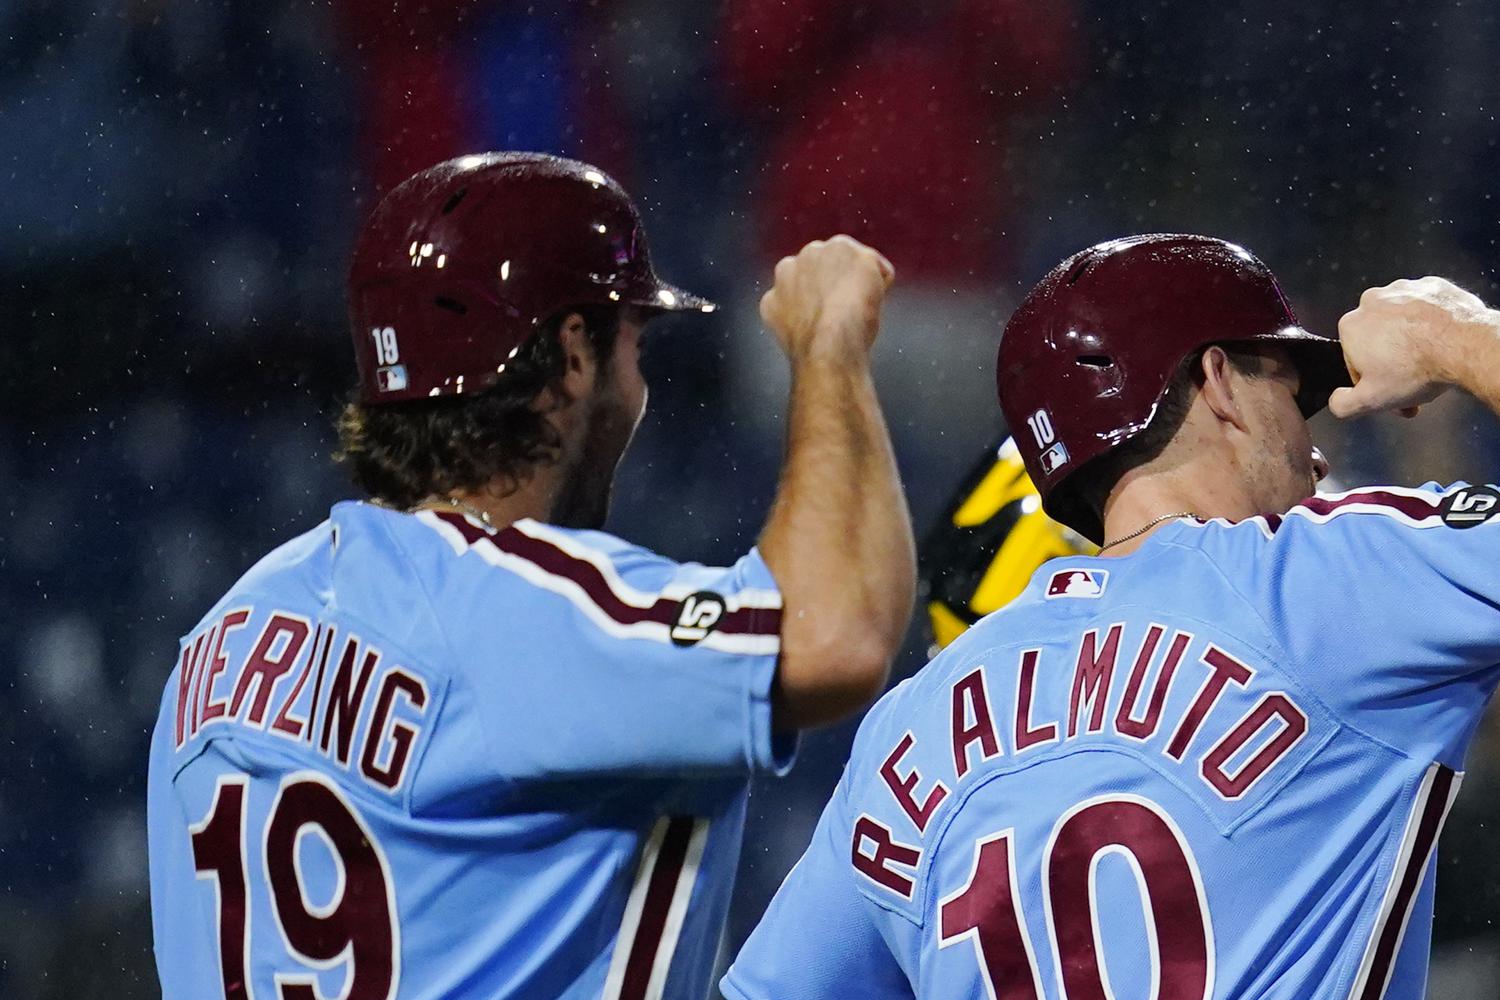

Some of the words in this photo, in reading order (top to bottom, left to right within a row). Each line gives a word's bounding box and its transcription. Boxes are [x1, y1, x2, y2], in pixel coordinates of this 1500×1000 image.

[371, 326, 400, 366] 19
[1027, 409, 1055, 449] 10
[850, 622, 1308, 900] REALMUTO
